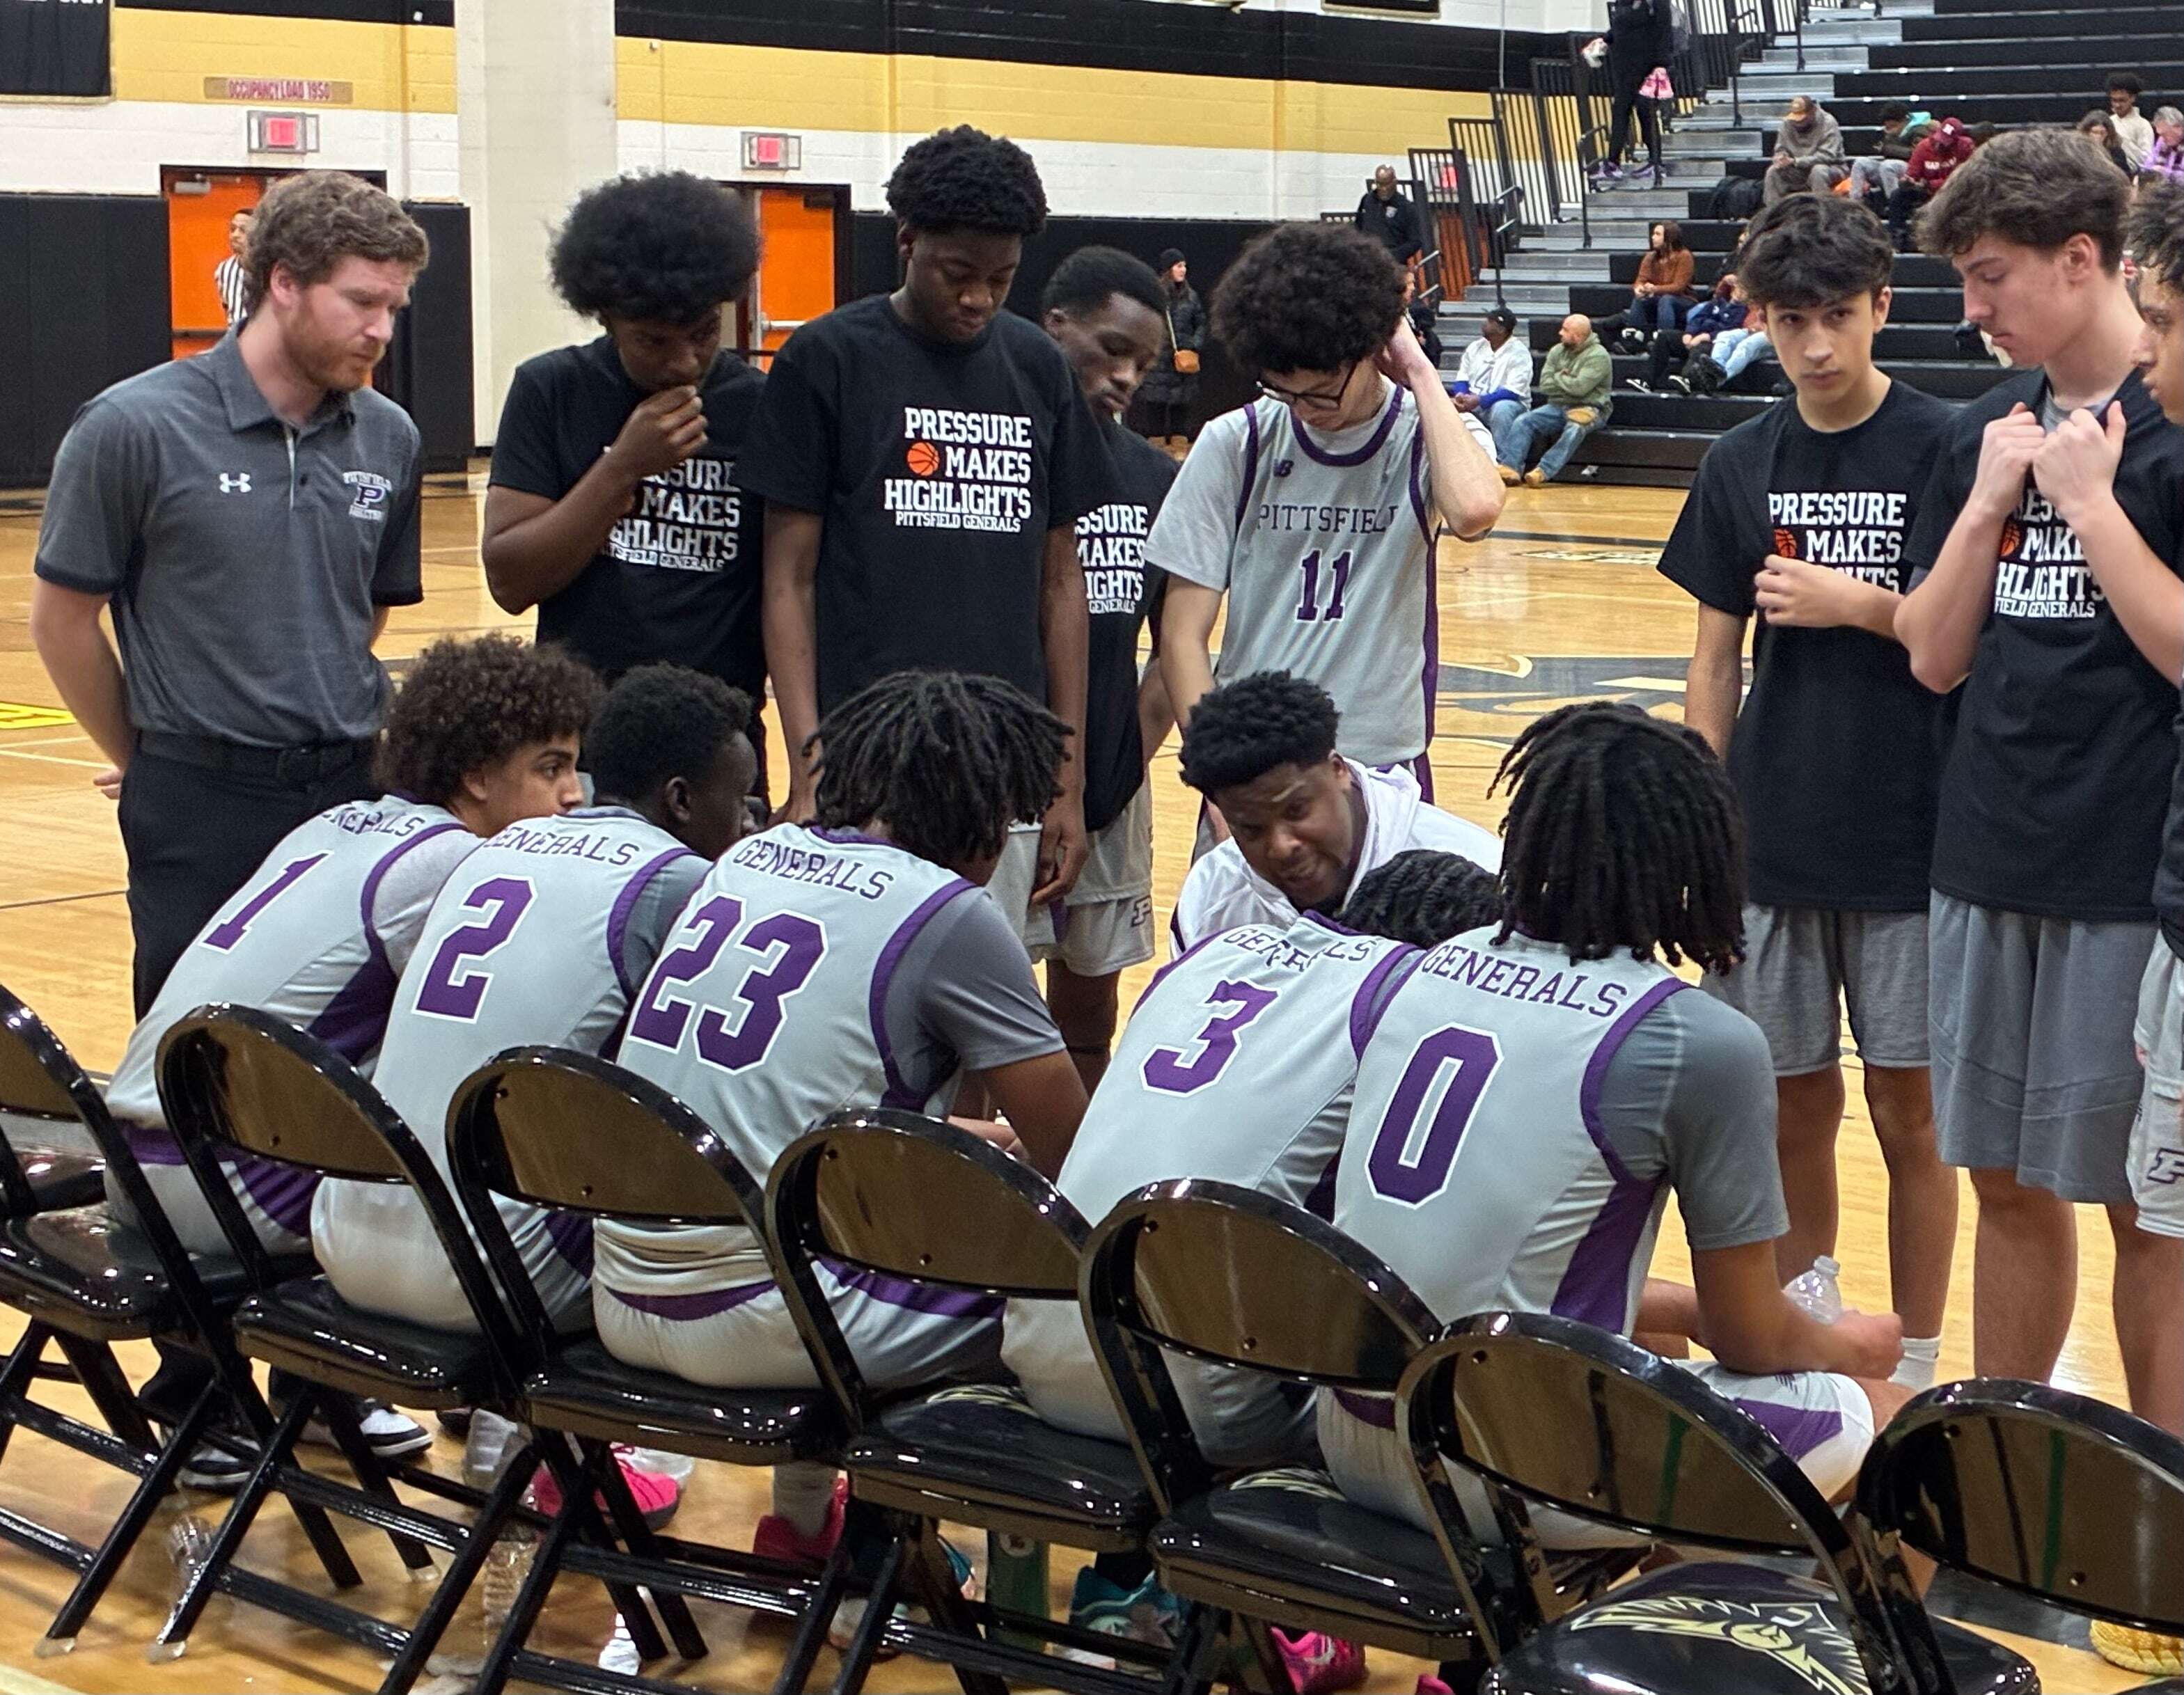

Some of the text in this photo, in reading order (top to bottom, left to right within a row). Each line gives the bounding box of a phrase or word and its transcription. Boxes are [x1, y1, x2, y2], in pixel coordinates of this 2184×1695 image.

[228, 80, 279, 100] OCCUPANCY
[281, 81, 304, 99] LOAD
[904, 407, 1033, 448] PRESSURE
[945, 446, 1032, 484] MAKES
[354, 482, 386, 509] P
[640, 487, 741, 528] MAKES
[884, 478, 1032, 519] HIGHLIGHTS
[1768, 491, 1907, 527] PRESSURE
[895, 510, 1021, 533] PITTSFIELD GENERALS
[1806, 529, 1903, 564] MAKES
[1296, 549, 1353, 622] 11
[2027, 601, 2096, 618] GENERALS
[732, 839, 894, 901] GENERALS
[198, 850, 334, 954] 1
[411, 874, 538, 1024] 2
[627, 891, 829, 1075] 23
[1421, 945, 1628, 1018] GENERALS
[1138, 977, 1282, 1098] 3
[1365, 1022, 1504, 1210] 0
